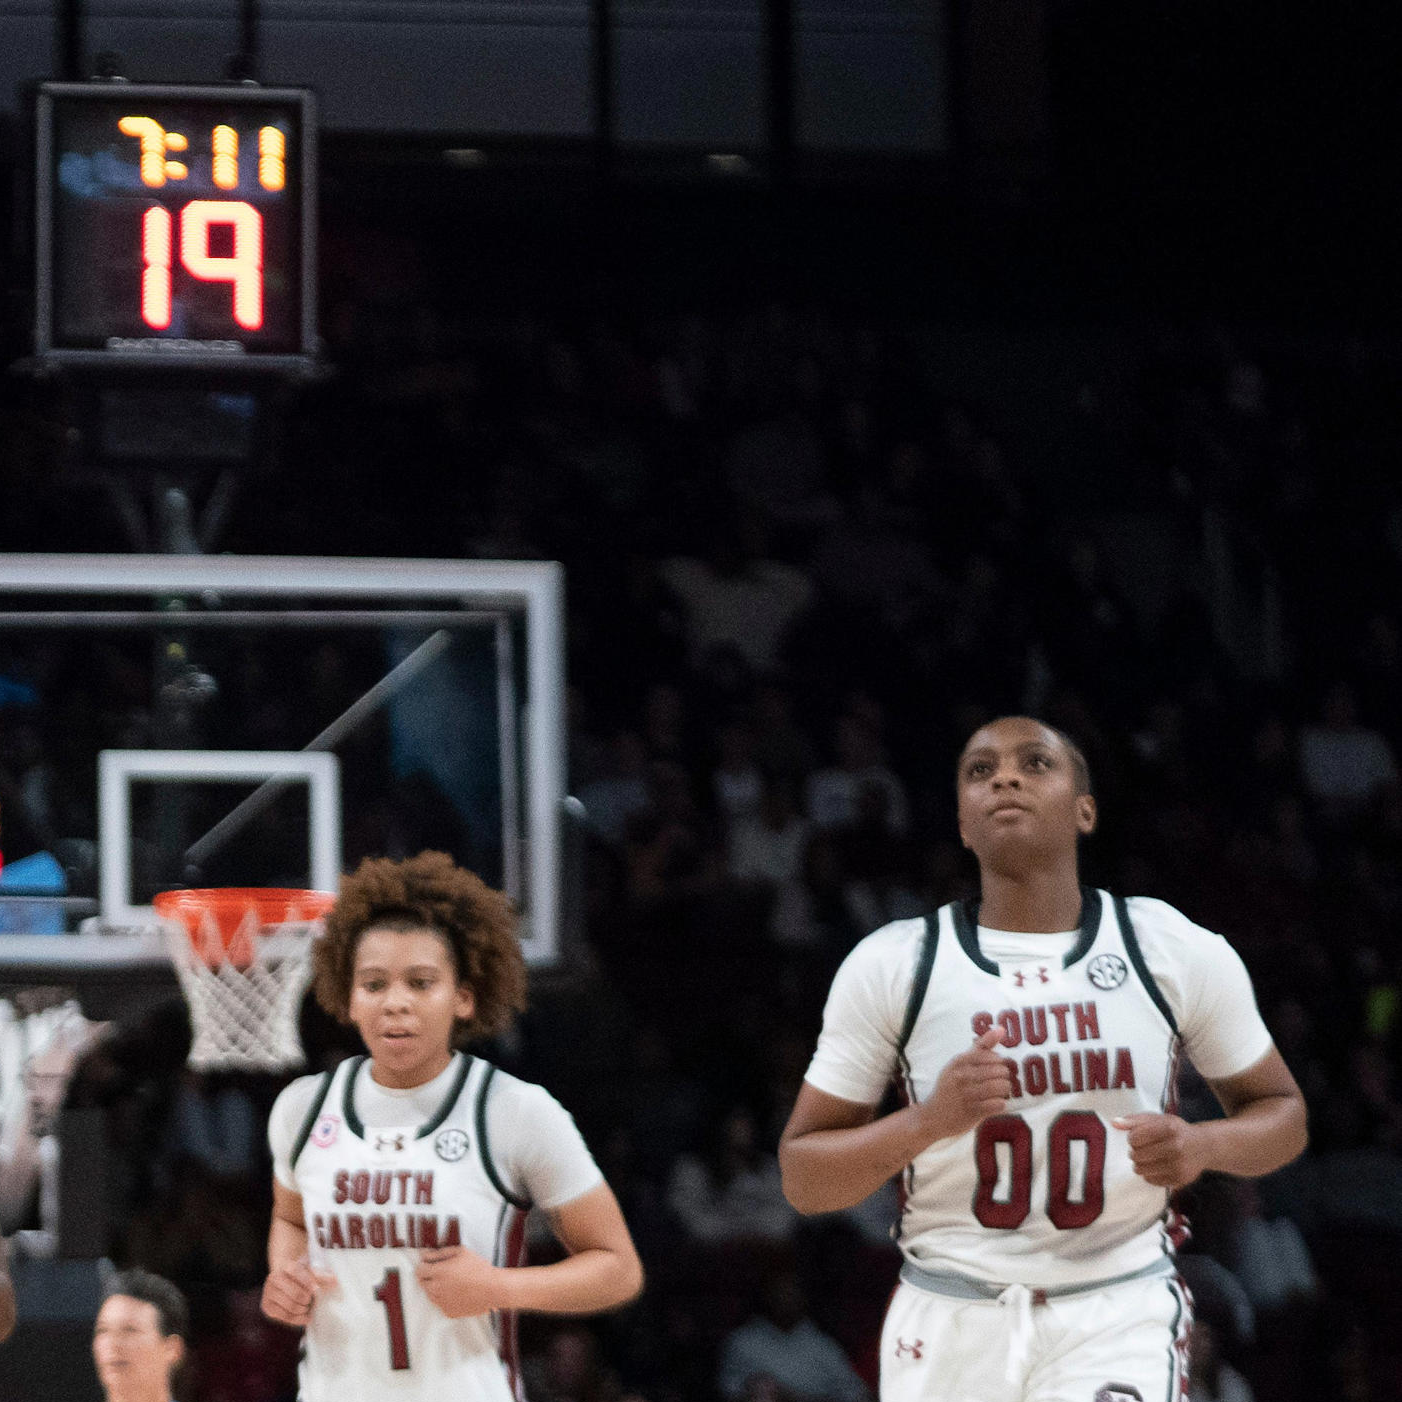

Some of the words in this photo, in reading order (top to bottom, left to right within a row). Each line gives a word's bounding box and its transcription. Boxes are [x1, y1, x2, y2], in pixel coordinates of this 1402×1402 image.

[118, 116, 286, 192] 7:11
[141, 200, 264, 331] 19
[972, 1001, 1100, 1048] SOUTH
[1003, 1047, 1136, 1098] ROLINA
[334, 1169, 435, 1205] SOUTH
[972, 1110, 1108, 1230] 00
[313, 1214, 462, 1250] CAROLINA
[374, 1268, 411, 1371] 1
